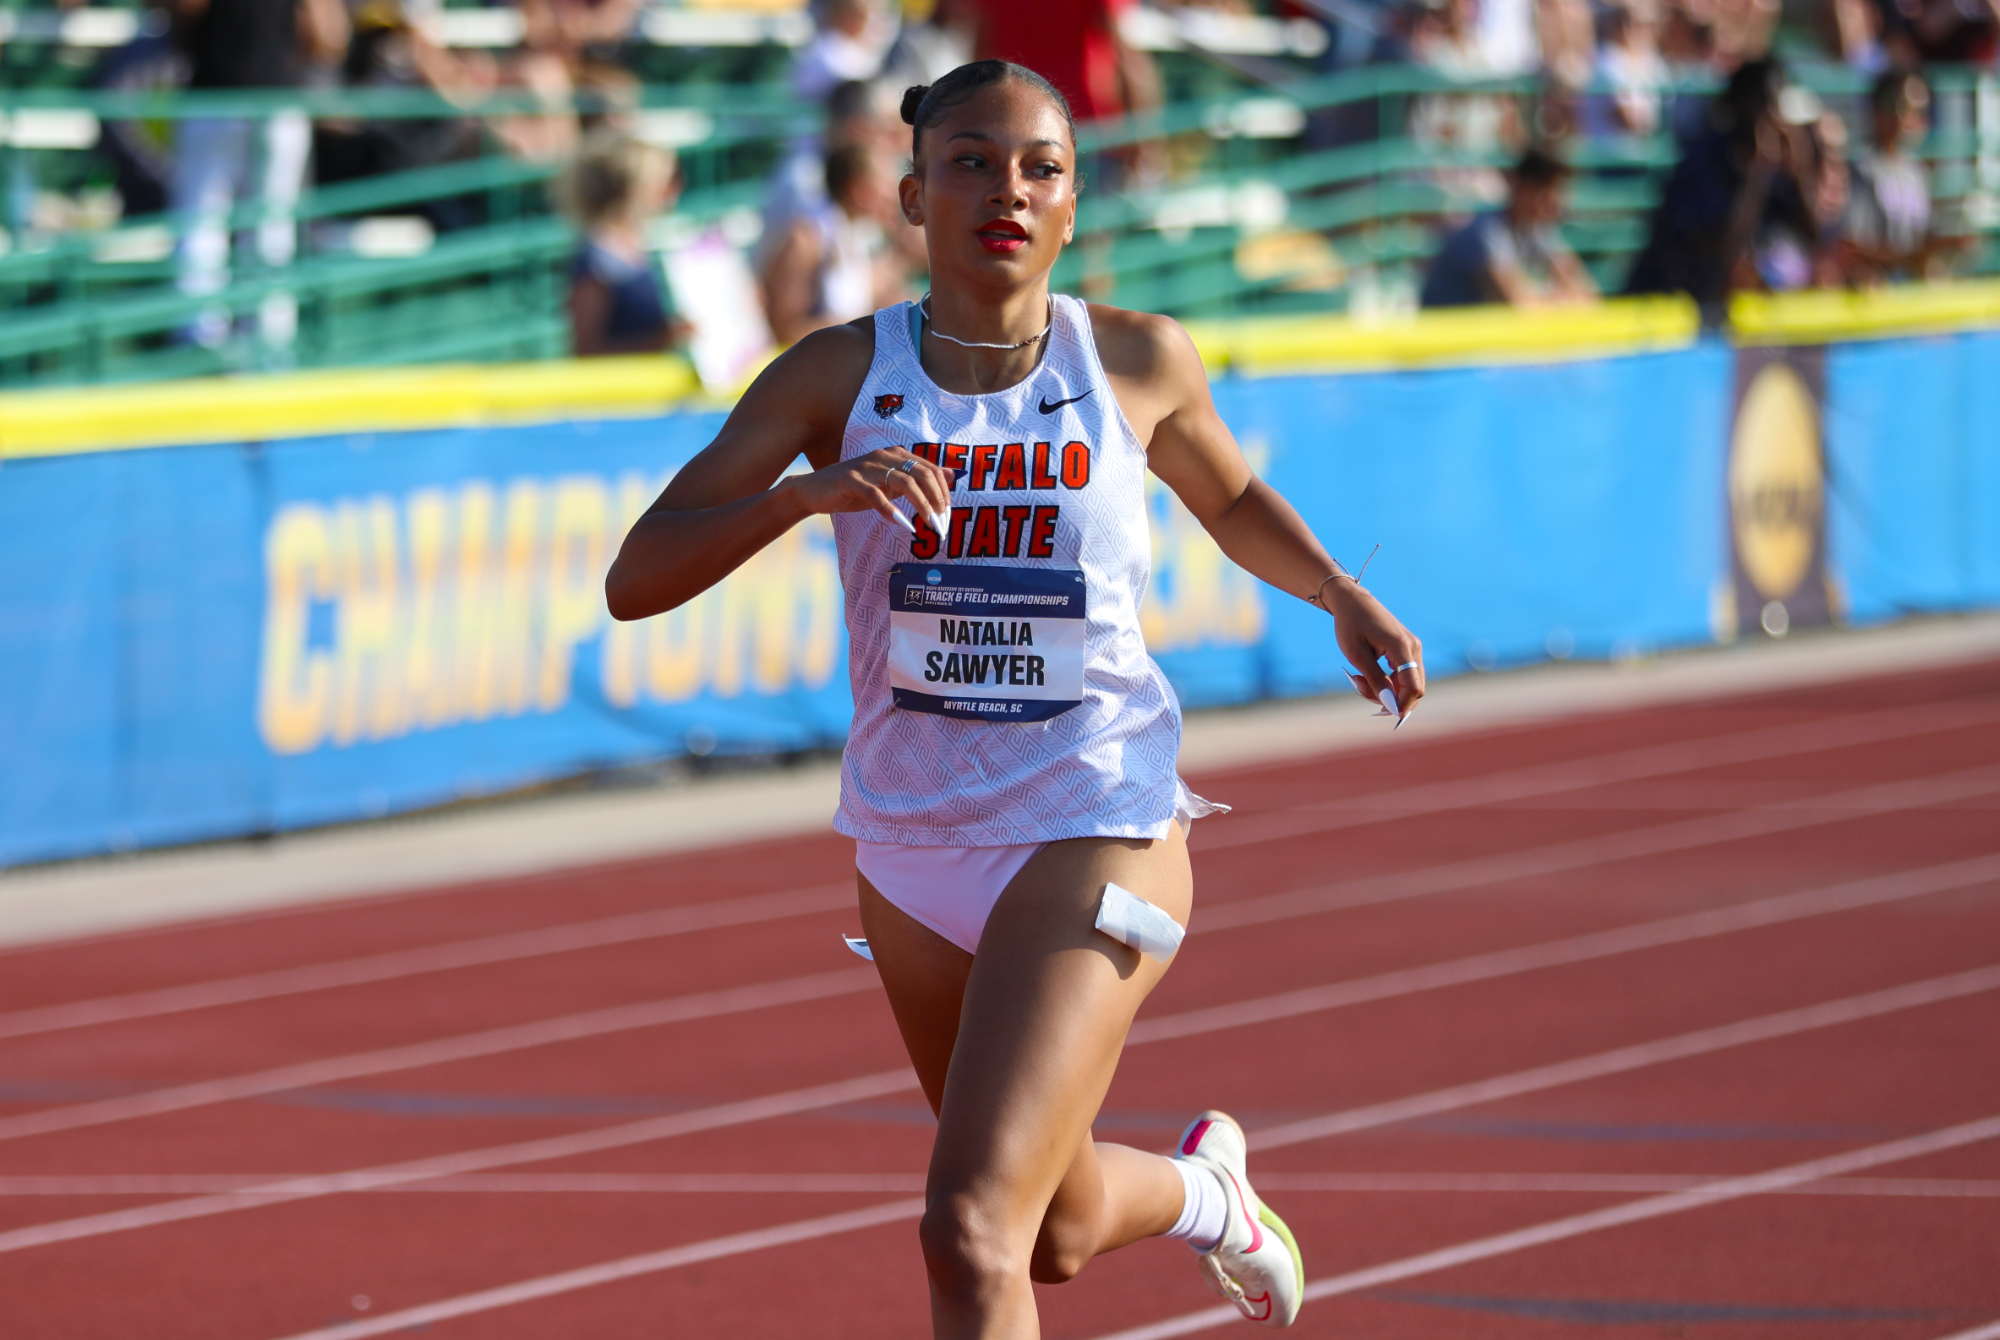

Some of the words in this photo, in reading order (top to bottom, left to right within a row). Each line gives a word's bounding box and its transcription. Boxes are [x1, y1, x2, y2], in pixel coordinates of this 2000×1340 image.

[911, 441, 1091, 492] FFALO
[910, 505, 1060, 560] STATE
[925, 591, 954, 602] TRACK
[955, 592, 962, 602] &
[963, 593, 989, 604] FIELD
[990, 594, 1069, 606] CHAMPIONSHIPS
[940, 618, 1033, 646] NATALIA
[924, 650, 1045, 686] SAWYER
[944, 700, 977, 711] MYRTLE
[978, 702, 1008, 714] BEACH,
[1010, 704, 1023, 713] SC
